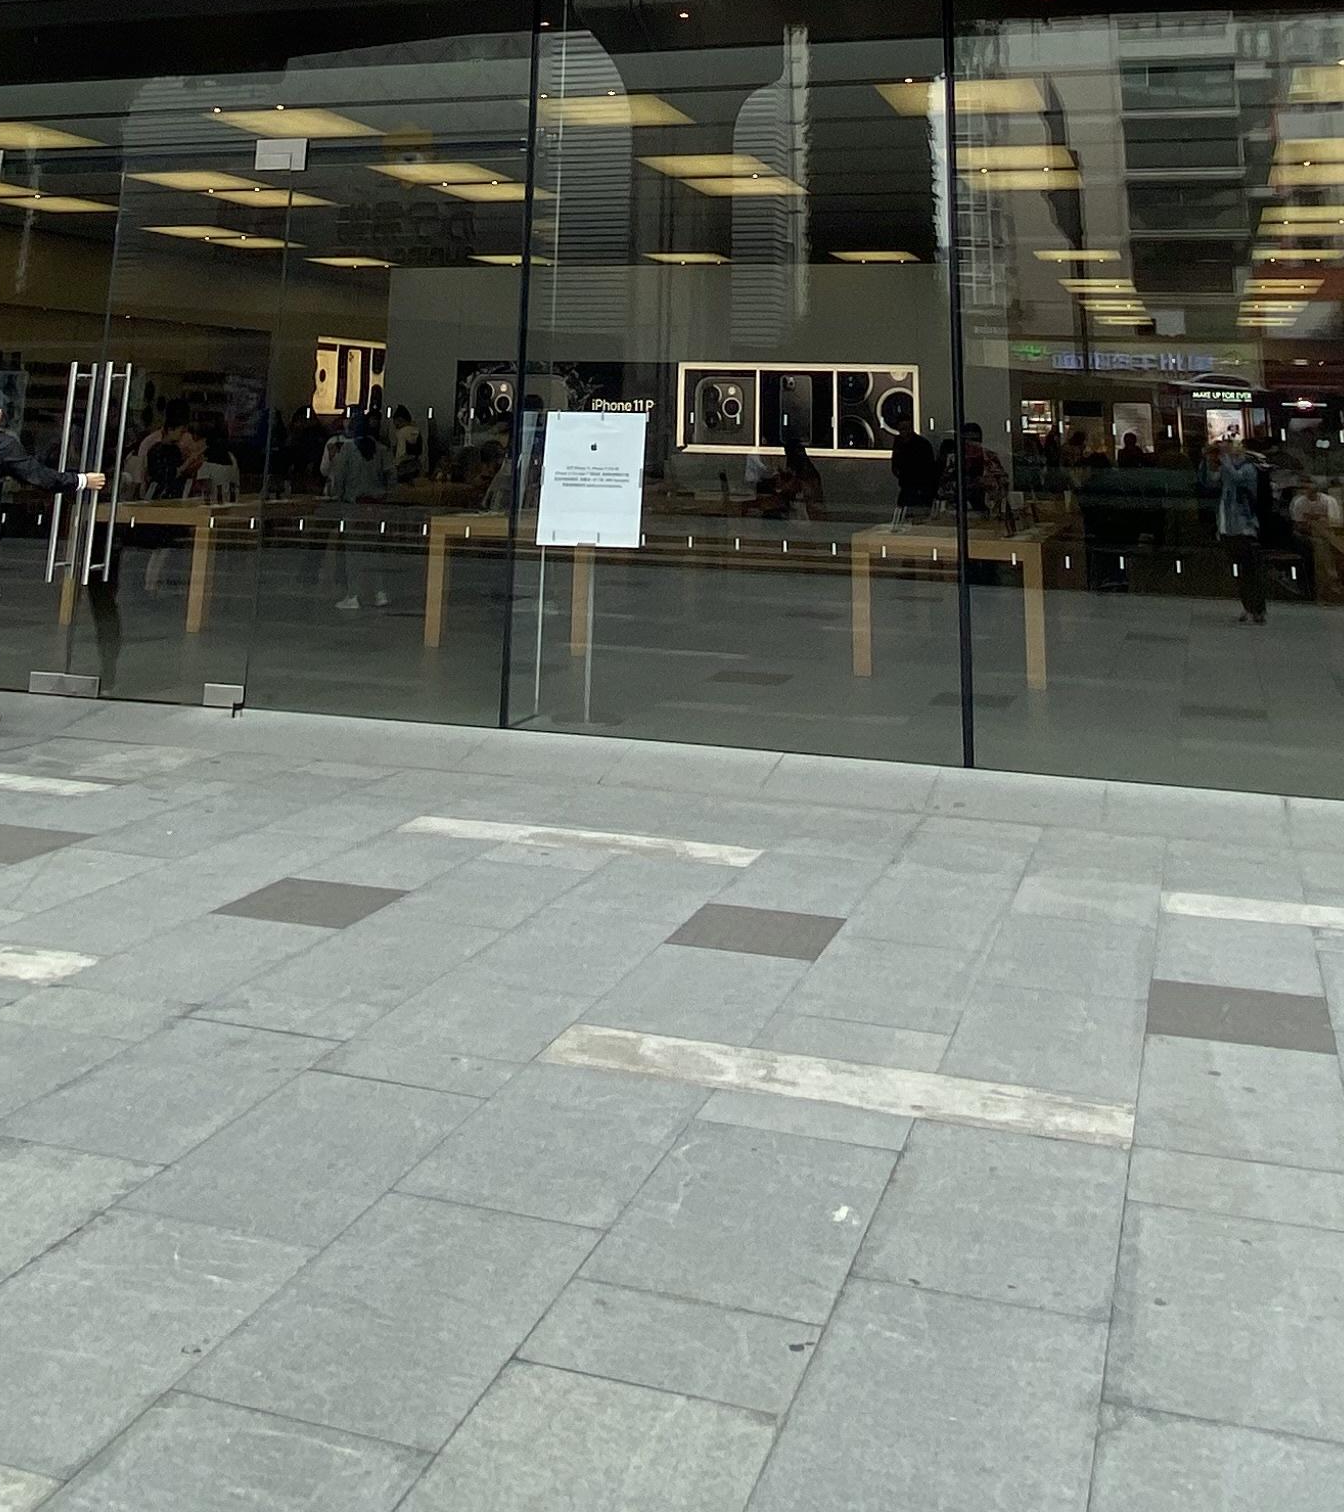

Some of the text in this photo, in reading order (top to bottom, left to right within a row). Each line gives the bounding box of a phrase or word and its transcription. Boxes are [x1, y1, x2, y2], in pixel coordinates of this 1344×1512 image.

[1192, 391, 1211, 399] MAKE
[1212, 391, 1222, 399] UP
[1222, 391, 1235, 399] FOR
[591, 398, 632, 412] iPhone
[633, 399, 644, 412] 11
